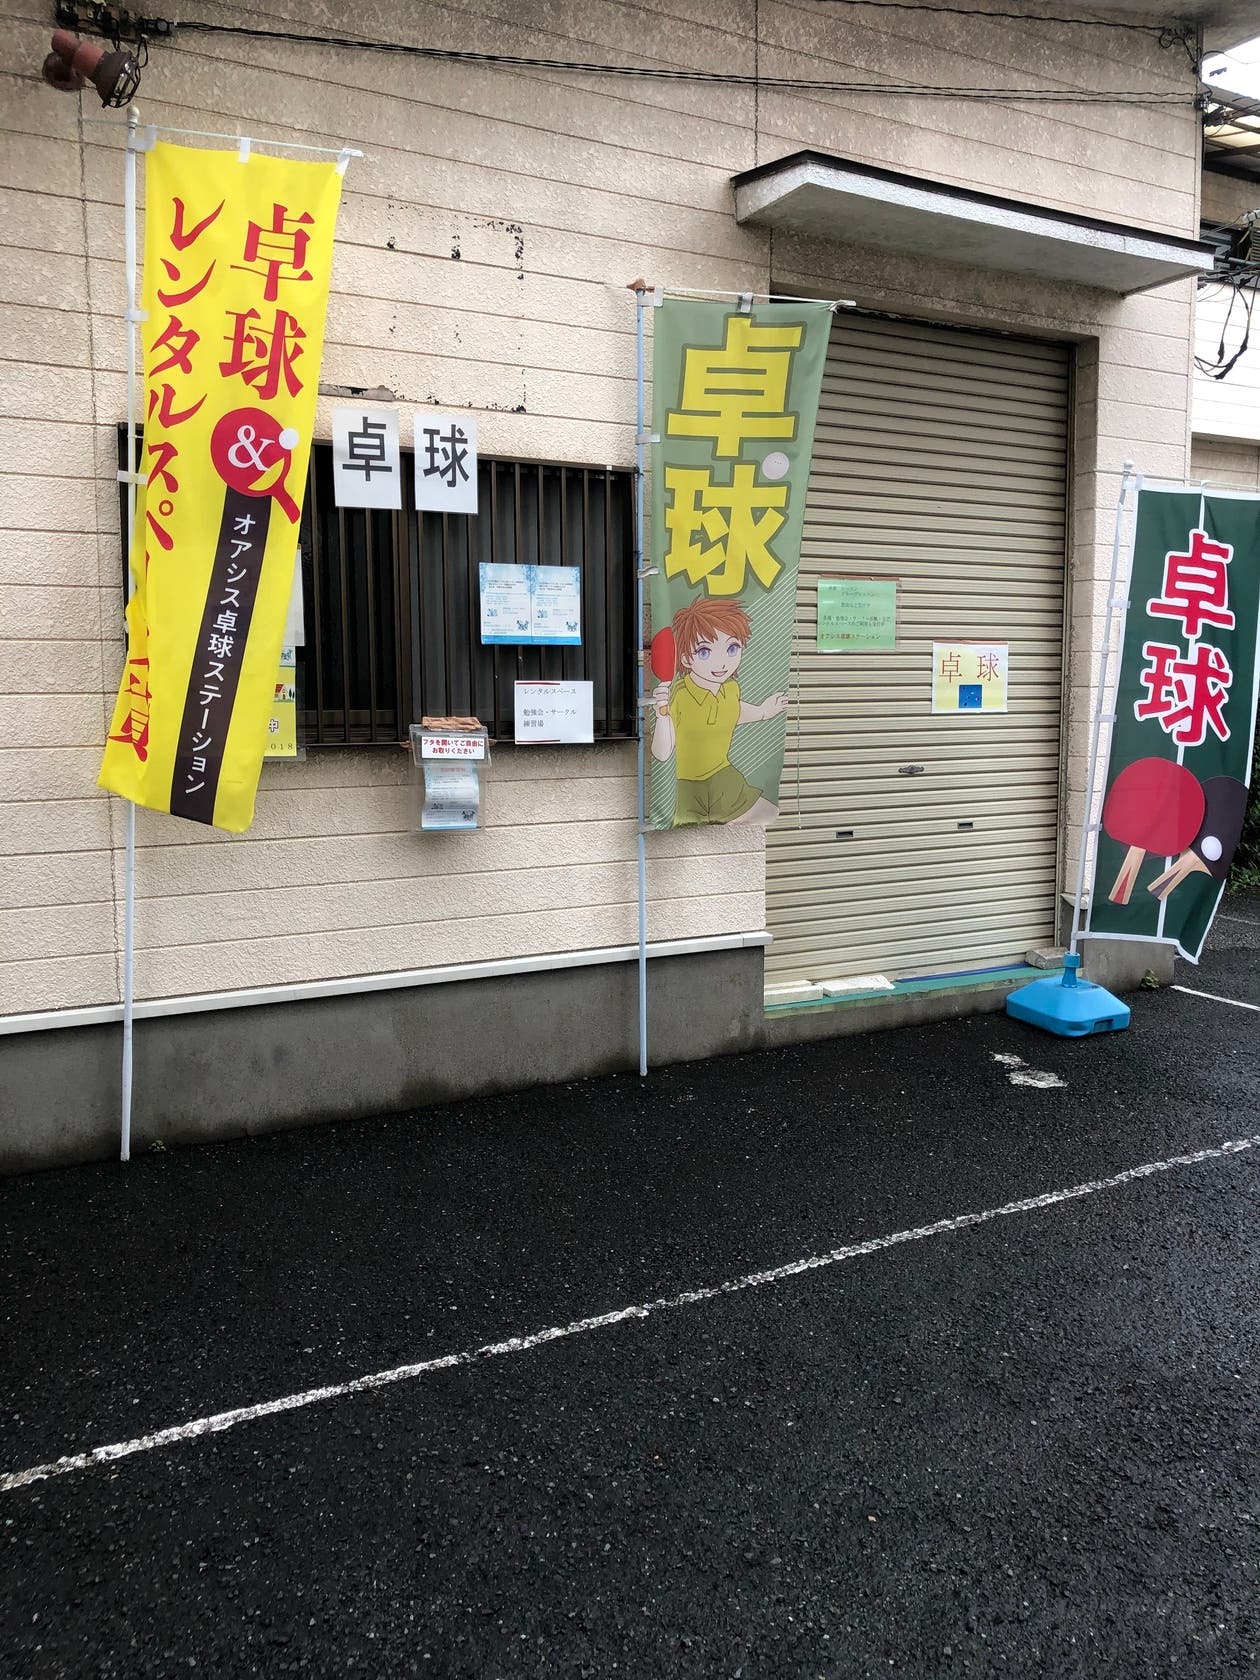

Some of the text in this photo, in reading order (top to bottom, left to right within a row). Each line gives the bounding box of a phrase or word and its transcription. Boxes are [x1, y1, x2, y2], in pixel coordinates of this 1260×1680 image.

[218, 202, 316, 473] 卓球 &
[342, 416, 470, 488] 卓球
[665, 316, 804, 597] 卓球
[185, 513, 256, 794] オアシス卓球ステーション
[939, 651, 999, 683] 卓球
[1134, 529, 1236, 747] 卓球
[422, 738, 484, 748] フタを開いてご自由に
[432, 747, 475, 755] お取りください
[523, 719, 544, 728] 練習場
